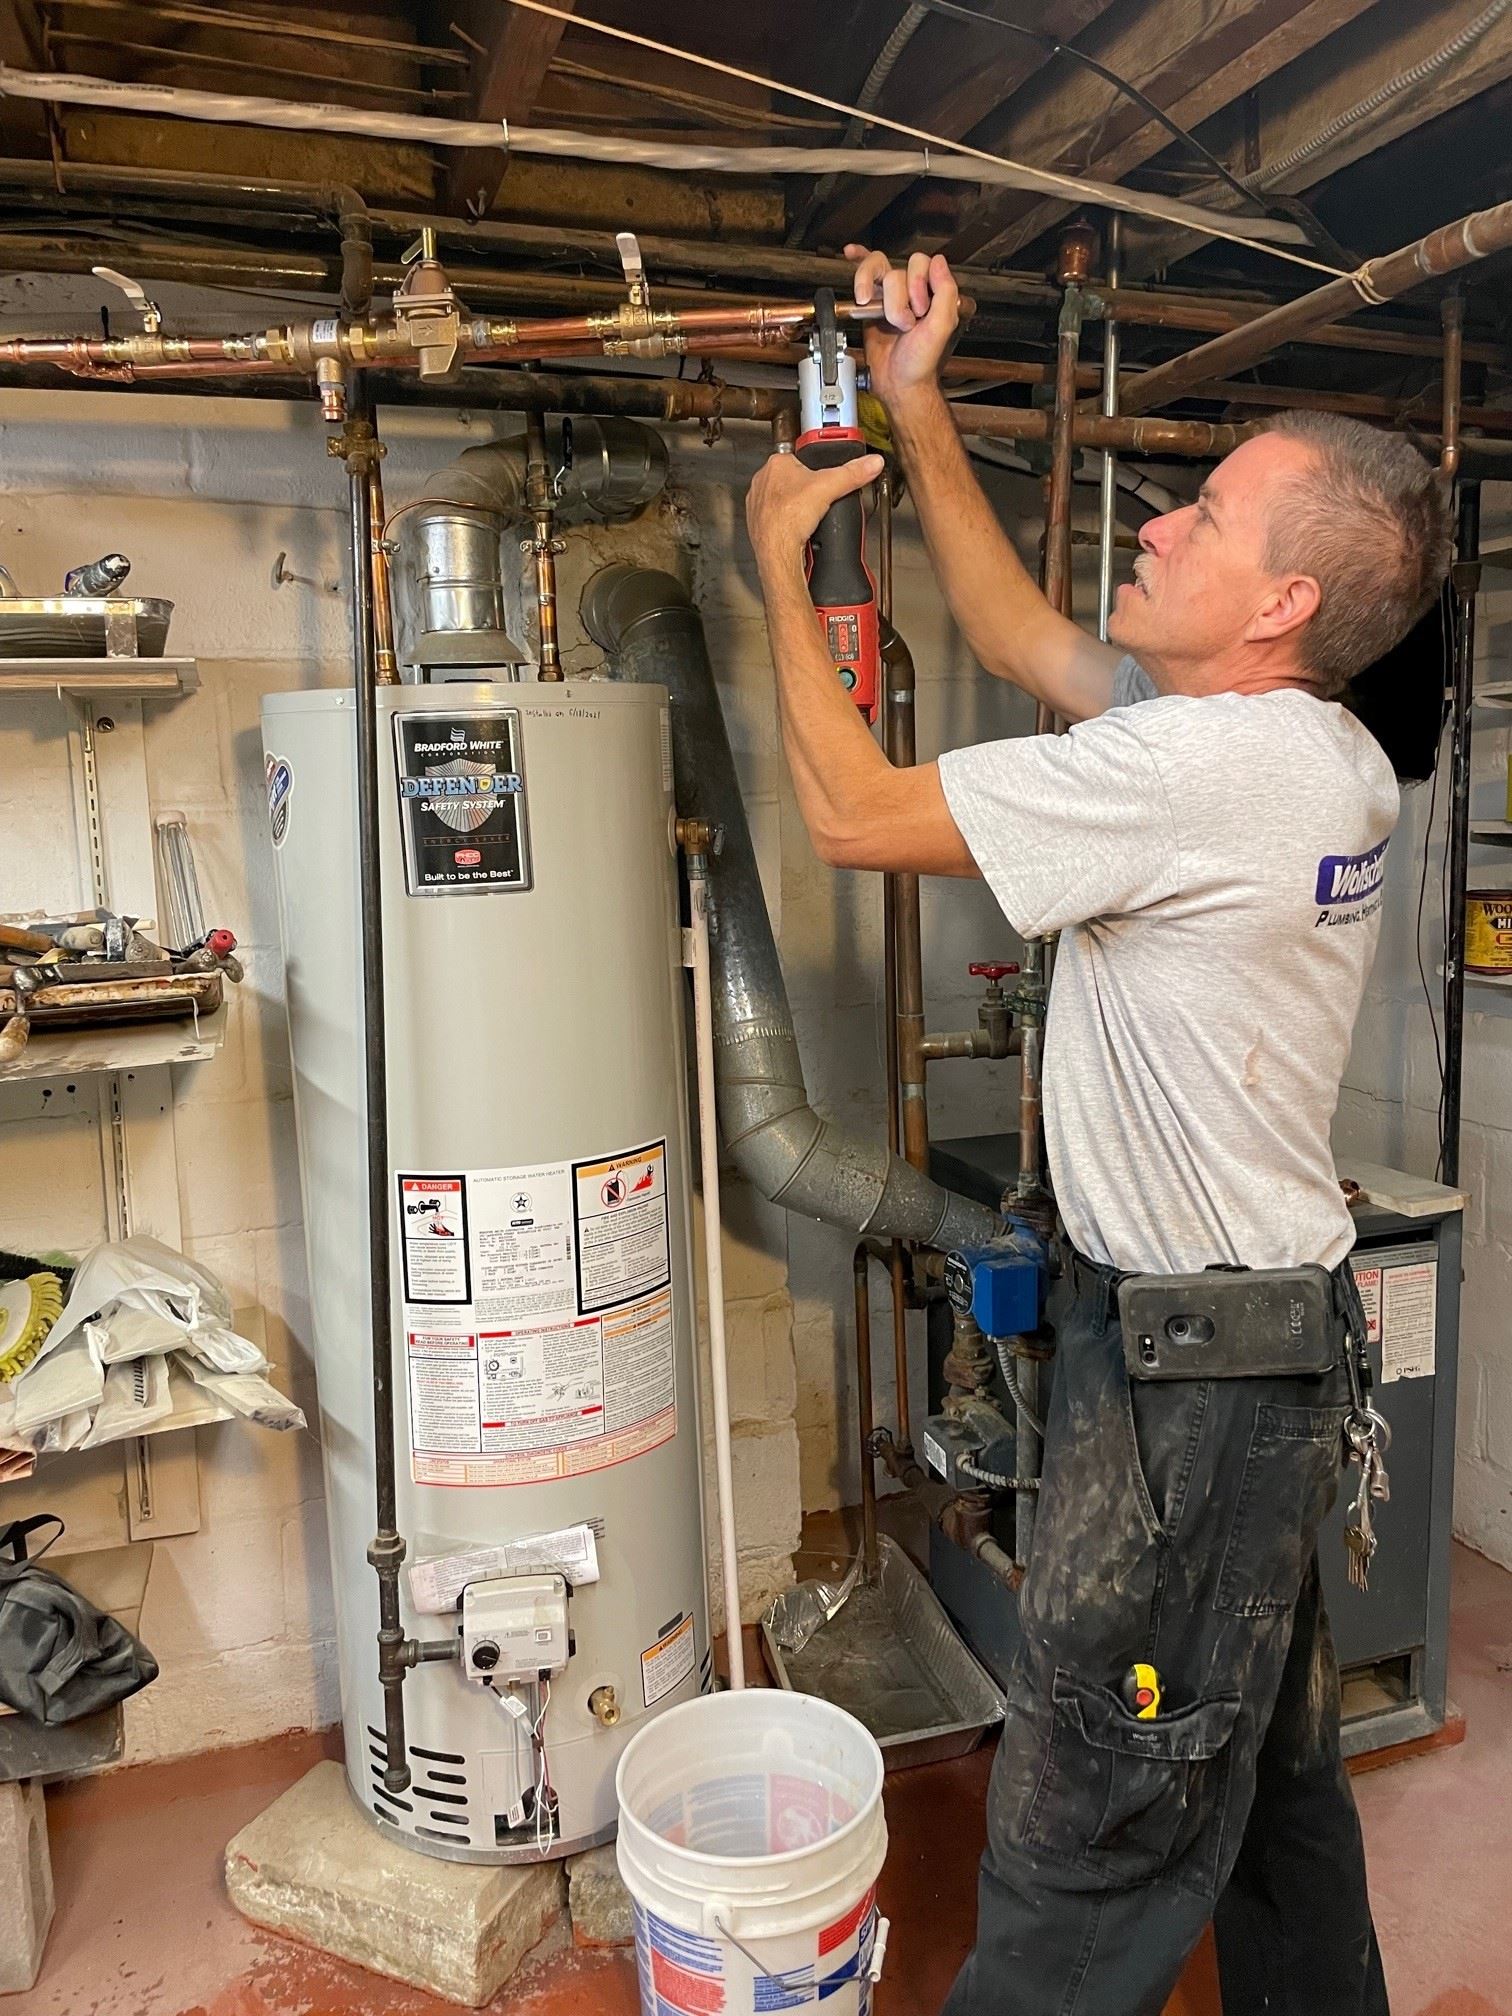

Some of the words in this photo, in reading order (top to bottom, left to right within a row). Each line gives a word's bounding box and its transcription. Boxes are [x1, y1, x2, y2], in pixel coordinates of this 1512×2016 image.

[414, 742, 467, 752] BRADFORD
[401, 773, 522, 797] DEFENDER
[421, 802, 460, 812] SAFETY
[424, 873, 444, 881] Built
[458, 871, 471, 880] be
[473, 871, 488, 879] the
[616, 1156, 642, 1168] WARNING
